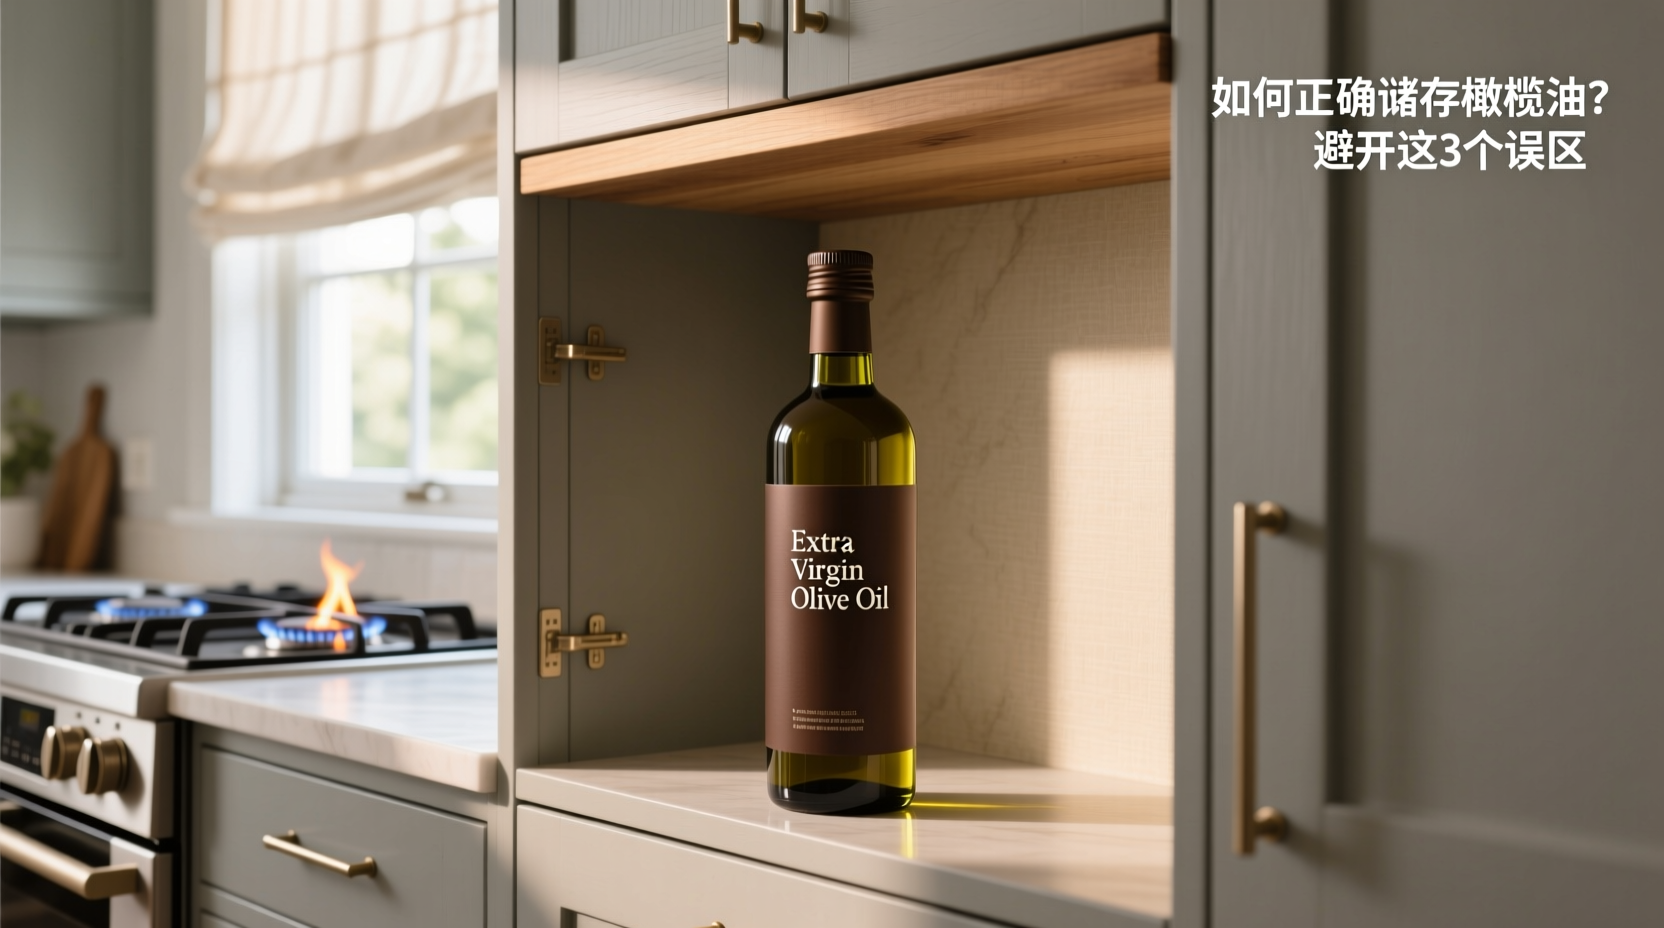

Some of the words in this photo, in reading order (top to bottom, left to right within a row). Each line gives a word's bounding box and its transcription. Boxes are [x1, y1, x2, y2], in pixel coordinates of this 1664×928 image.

[790, 529, 855, 554] Extra
[790, 557, 864, 588] Virgin
[790, 585, 850, 611] Olive
[855, 585, 889, 611] Oil
